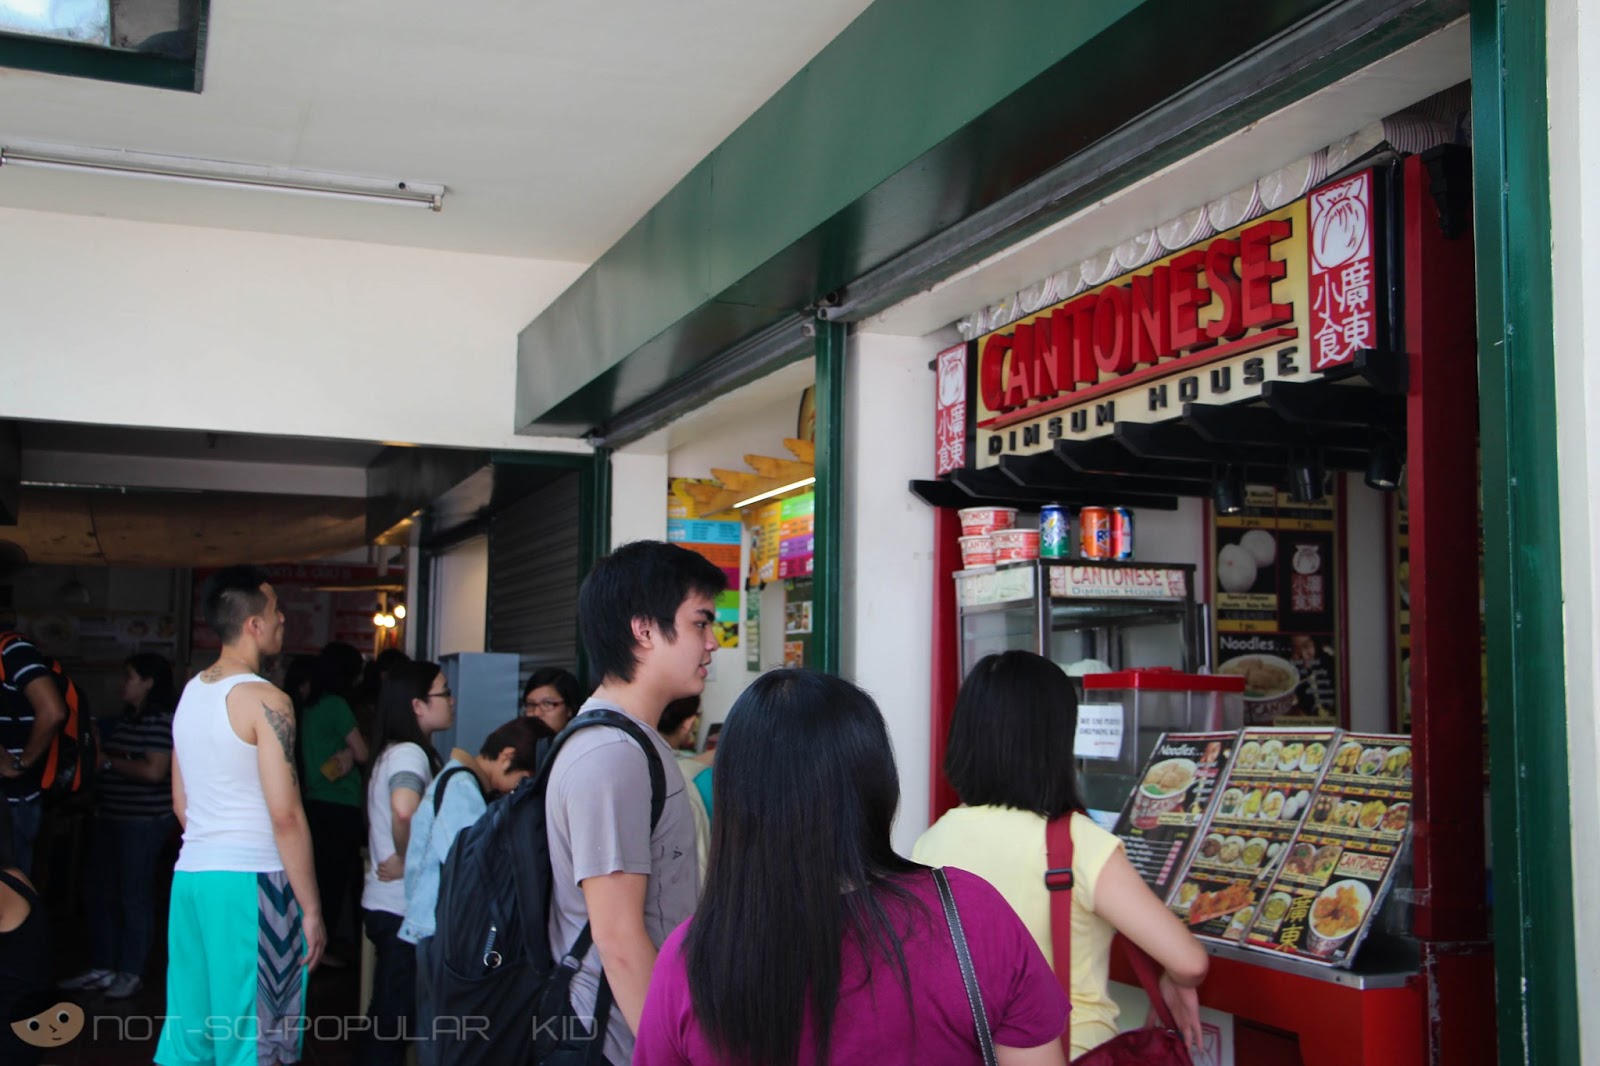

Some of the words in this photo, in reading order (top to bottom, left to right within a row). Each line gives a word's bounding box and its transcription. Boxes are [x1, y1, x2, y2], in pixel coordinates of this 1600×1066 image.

[981, 218, 1293, 412] CANTONESE
[1313, 274, 1353, 368] 小食
[1339, 262, 1371, 352] 廣東
[988, 401, 1115, 456] DIMSUM
[1149, 346, 1299, 410] HOUSE
[1071, 566, 1163, 586] CANTONESE
[1072, 587, 1120, 596] DIMSUM
[1124, 588, 1166, 596] HOUSE
